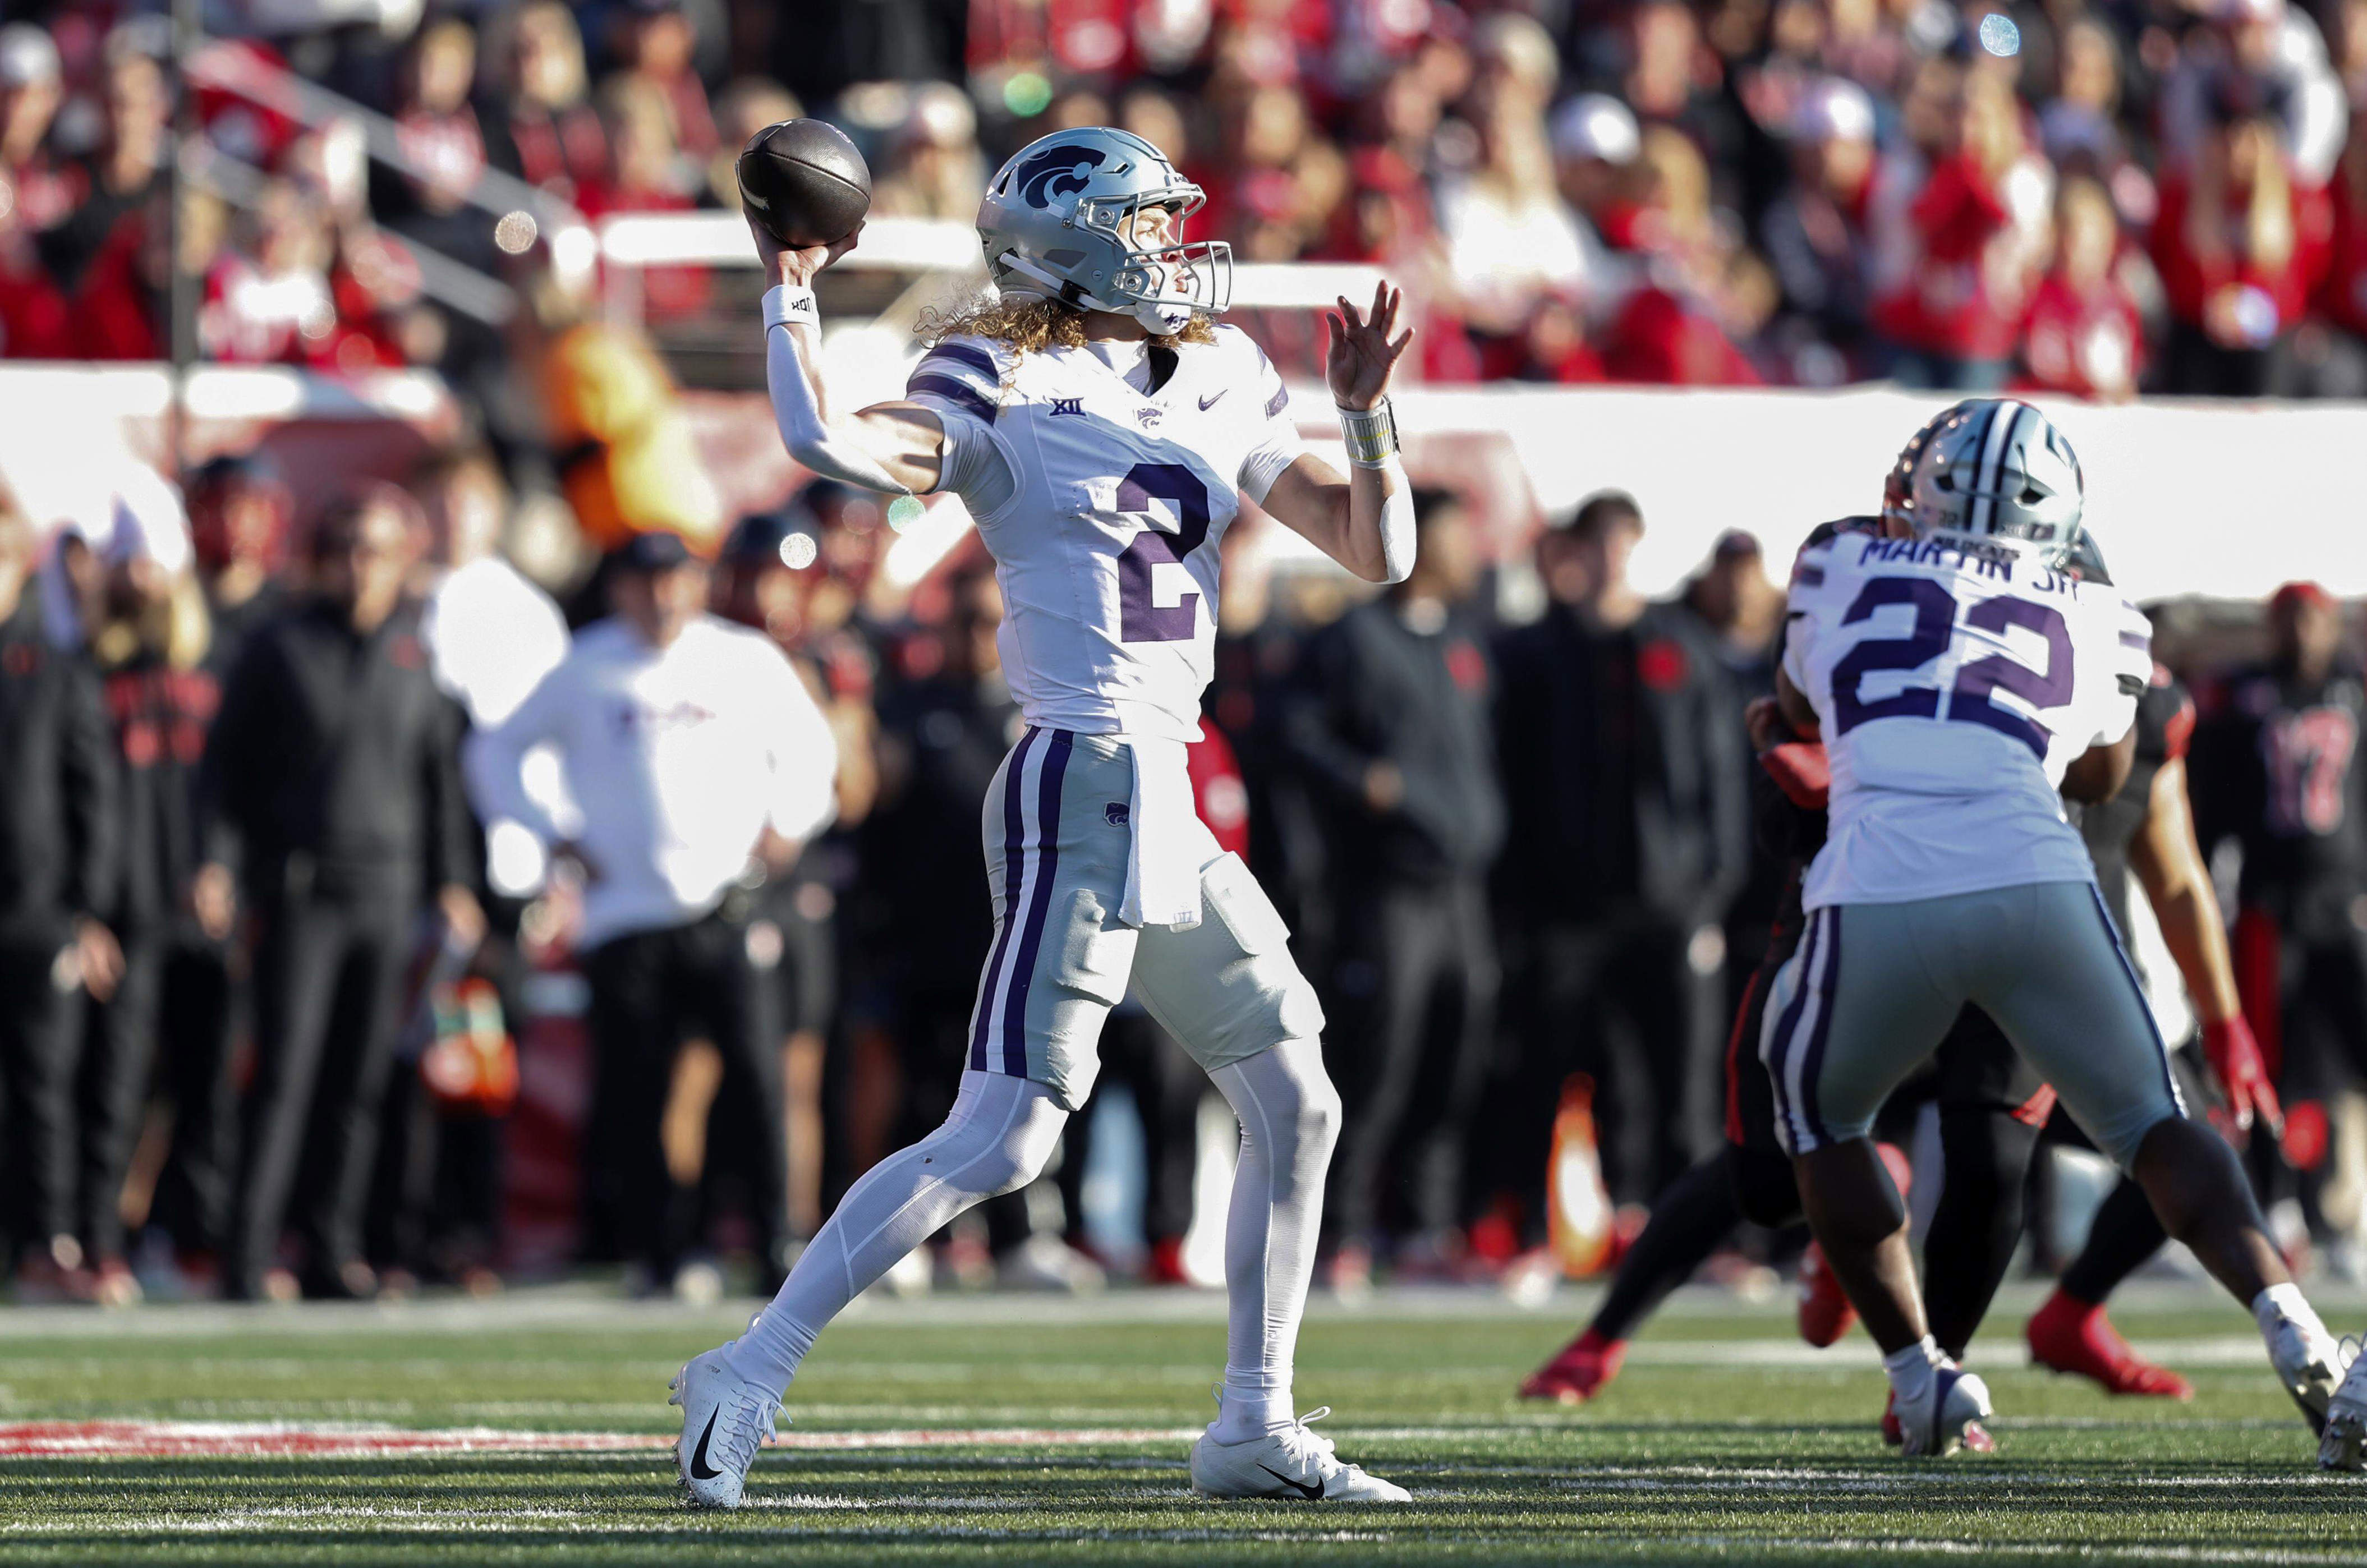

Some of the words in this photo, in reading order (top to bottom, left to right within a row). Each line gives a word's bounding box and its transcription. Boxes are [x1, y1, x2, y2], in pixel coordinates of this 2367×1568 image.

[1049, 397, 1086, 416] XII
[1116, 463, 1210, 642] 2
[1830, 576, 2074, 762] 22
